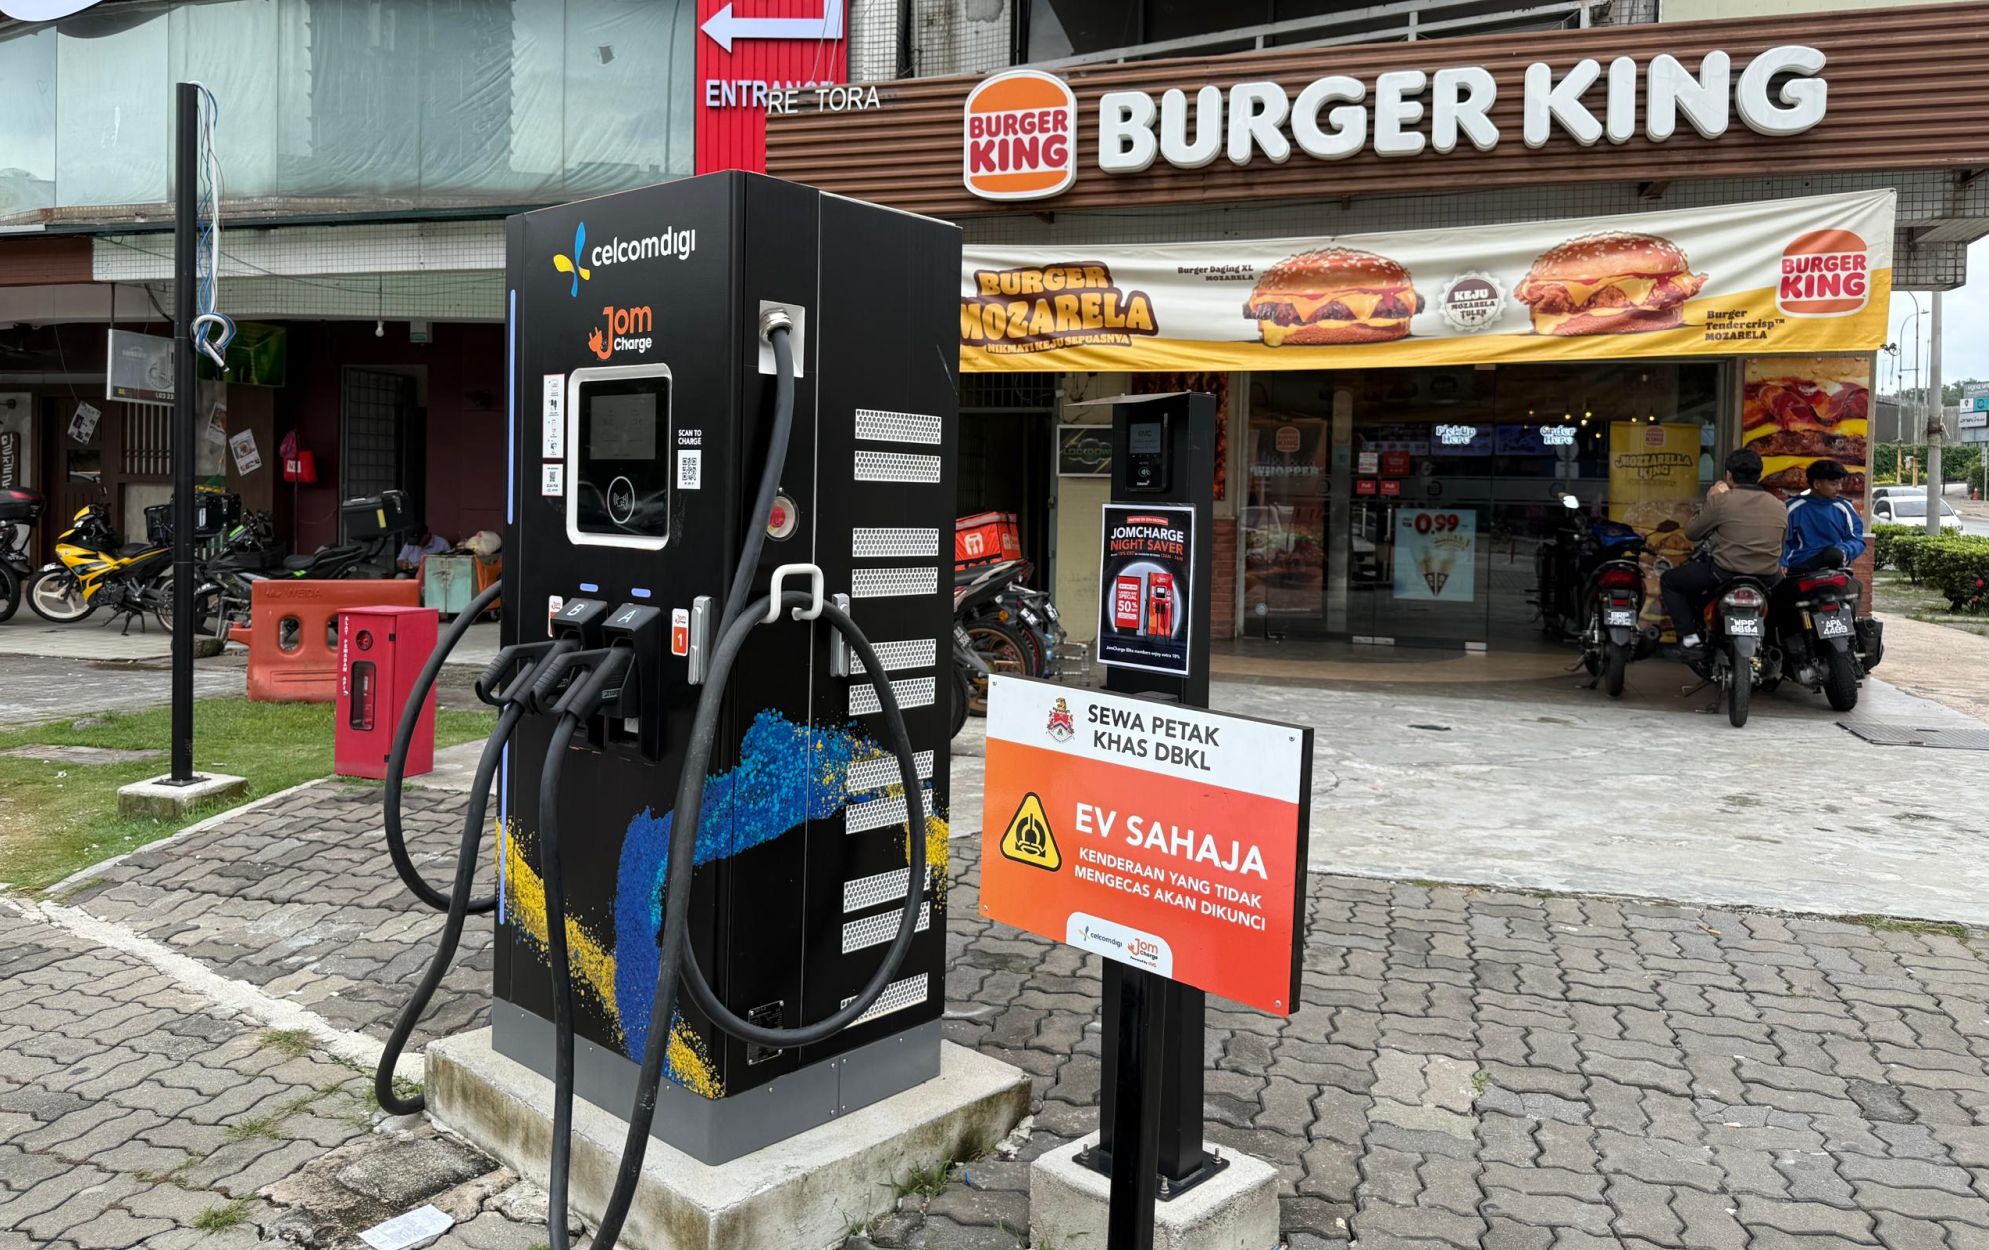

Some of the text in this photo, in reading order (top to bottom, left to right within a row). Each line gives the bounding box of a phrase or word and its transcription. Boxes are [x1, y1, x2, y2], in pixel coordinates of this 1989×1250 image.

[815, 86, 881, 113] TORA
[1098, 45, 1828, 173] BURGER KING
[969, 109, 1068, 139] BURGER
[970, 134, 1069, 173] KING
[591, 225, 696, 267] celcomdigi
[1177, 264, 1254, 275] Burger Daging XL
[1781, 254, 1867, 275] BURGER
[977, 266, 1109, 297] BURGER
[1780, 272, 1866, 299] KING
[1454, 288, 1489, 301] KEJU
[1451, 301, 1496, 310] MOZARELA
[1460, 309, 1487, 319] TULEN
[1706, 309, 1748, 320] Burger
[960, 292, 1153, 340] MOZARELA
[598, 305, 653, 360] Jom
[1704, 330, 1768, 341] MOZARELA
[613, 336, 653, 354] Charge
[1035, 338, 1064, 350] KEJU
[1065, 334, 1130, 346] SEPUASNYA
[677, 429, 702, 438] SCAN TO
[677, 437, 702, 446] CHARGE
[1413, 512, 1460, 535] 0.99
[1110, 526, 1184, 543] JOMCHARGE
[1110, 539, 1145, 551] NIGHT
[1147, 540, 1184, 555] SAVER
[566, 603, 585, 616] B
[617, 609, 637, 623] A
[1825, 619, 1843, 628] APA
[678, 633, 683, 647] 1
[1087, 704, 1220, 747] SEWA PETAK
[1093, 730, 1211, 771] KHAS DBKL
[1075, 802, 1268, 880] EV SAHAJA
[1079, 847, 1262, 909] KENDERAAN YANG TIDAK
[1074, 864, 1266, 931] MENGECAS AKAN DIKUNCI
[1090, 932, 1123, 948] celcomdigi
[1132, 938, 1158, 956] Jom
[1140, 950, 1158, 961] Charge
